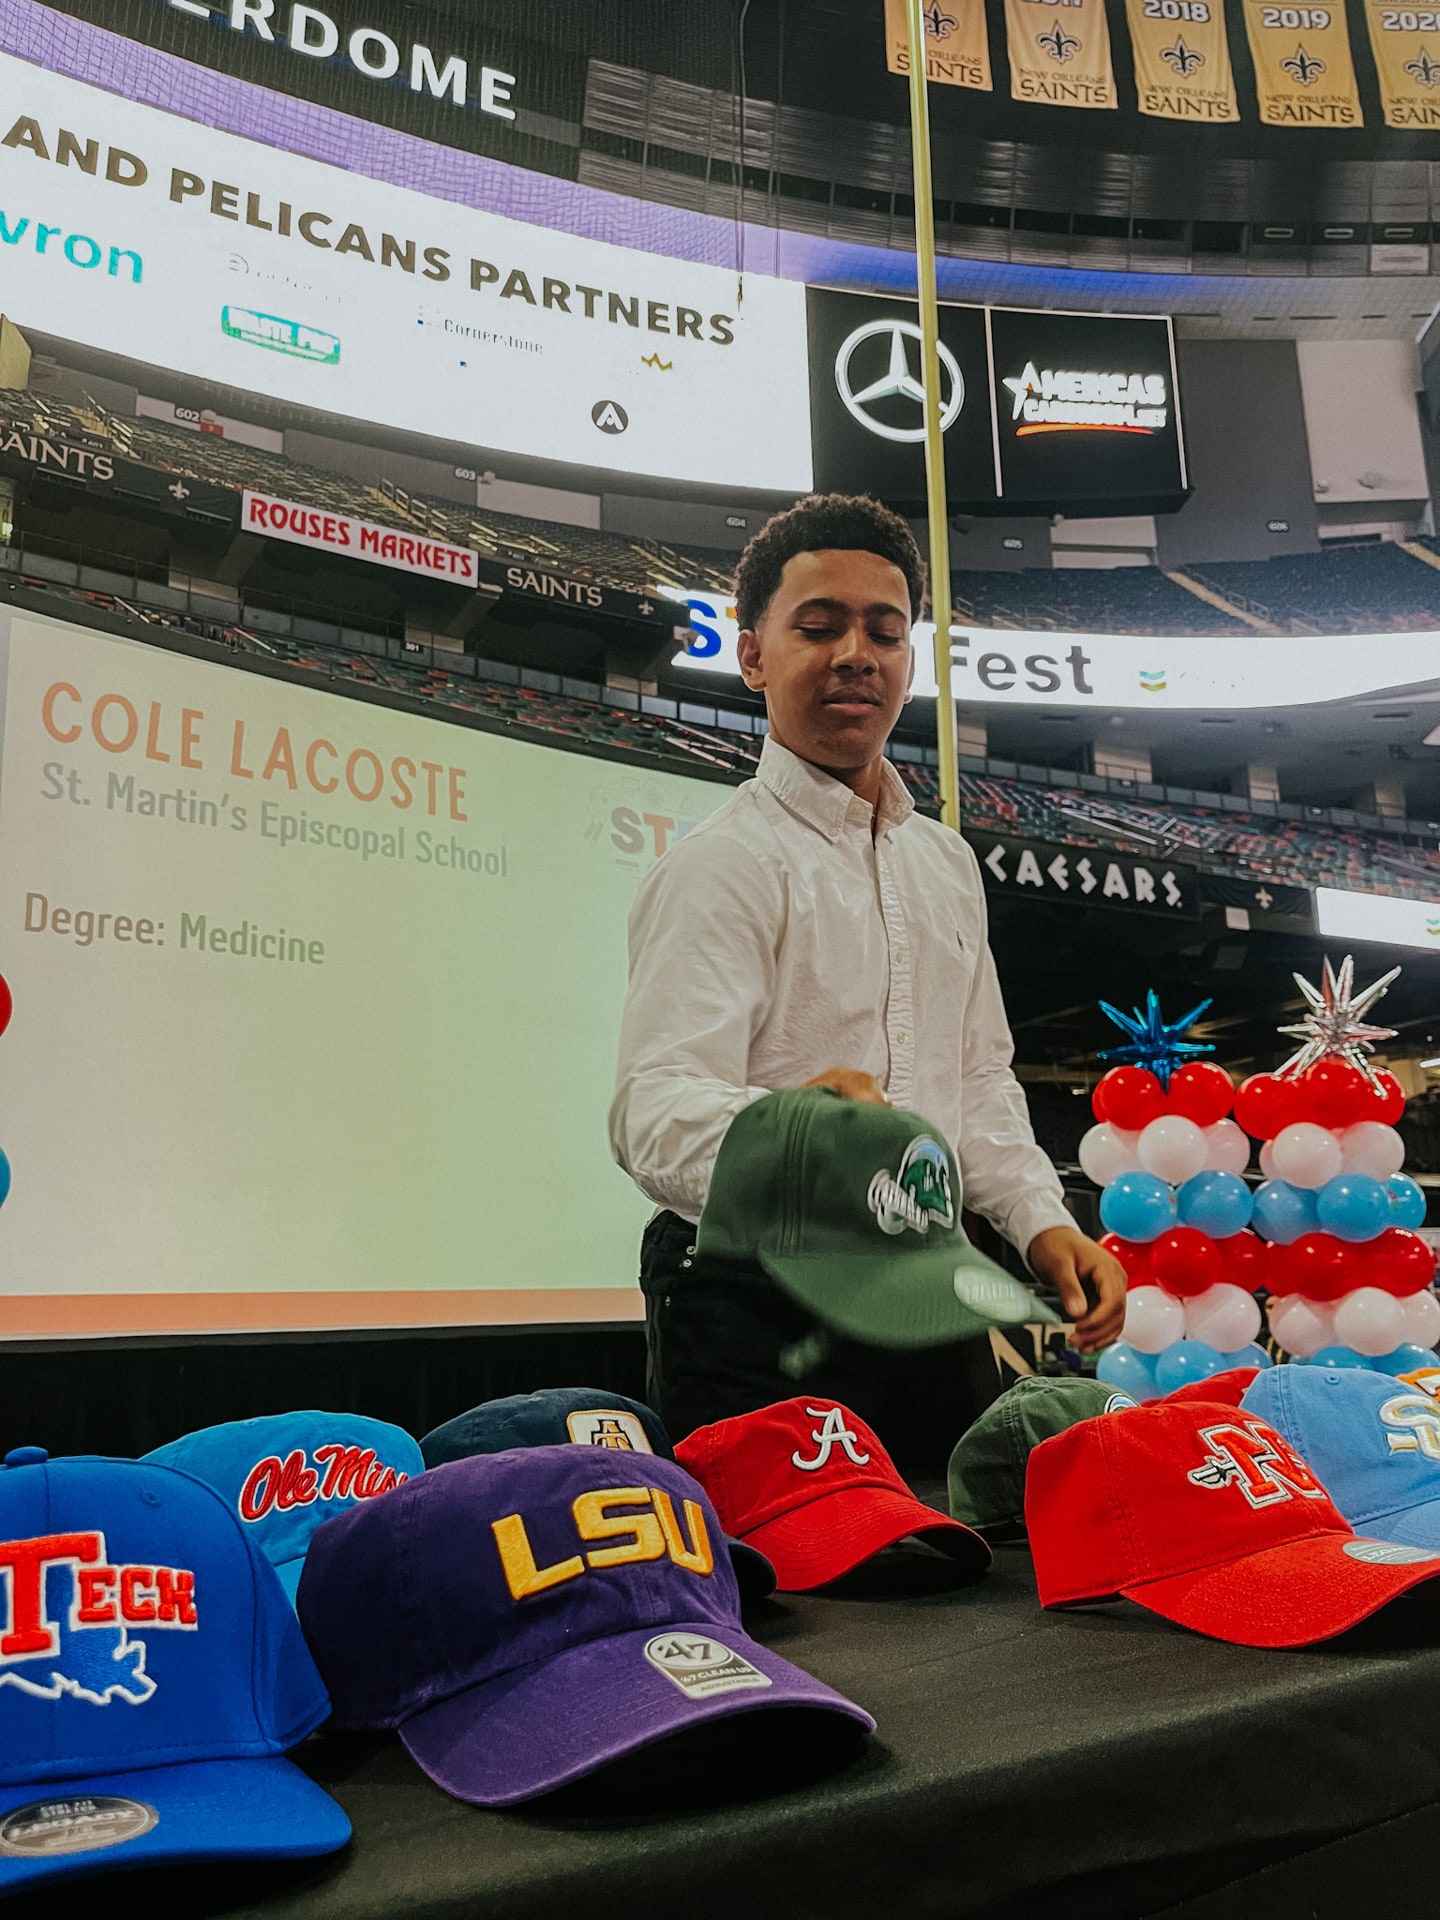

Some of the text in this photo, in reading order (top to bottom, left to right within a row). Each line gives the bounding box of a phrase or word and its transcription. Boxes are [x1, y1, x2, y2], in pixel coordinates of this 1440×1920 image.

[1144, 0, 1210, 23] 2018
[1262, 8, 1331, 30] 2019
[168, 0, 517, 121] RDOME
[896, 53, 984, 85] SINTS
[1021, 78, 1109, 104] SAINTS
[1145, 94, 1231, 119] SAINTS
[1267, 103, 1355, 124] SAINTS
[1, 114, 149, 188] AND
[169, 166, 452, 282] PELICANS
[469, 257, 736, 347] PARTNERS
[175, 406, 200, 426] 602
[454, 467, 476, 481] 603
[249, 497, 474, 579] ROUSES MARKETS
[506, 566, 603, 607] SAINTS
[41, 681, 469, 823] COLE LACOSTE
[40, 761, 509, 878] St. Martin's Episcopal School
[24, 892, 326, 965] Degree: Medicine
[791, 1406, 870, 1471] A
[241, 1445, 409, 1522] Ole Mis
[491, 1486, 713, 1602] LSU
[697, 1667, 737, 1680] CLEAN
